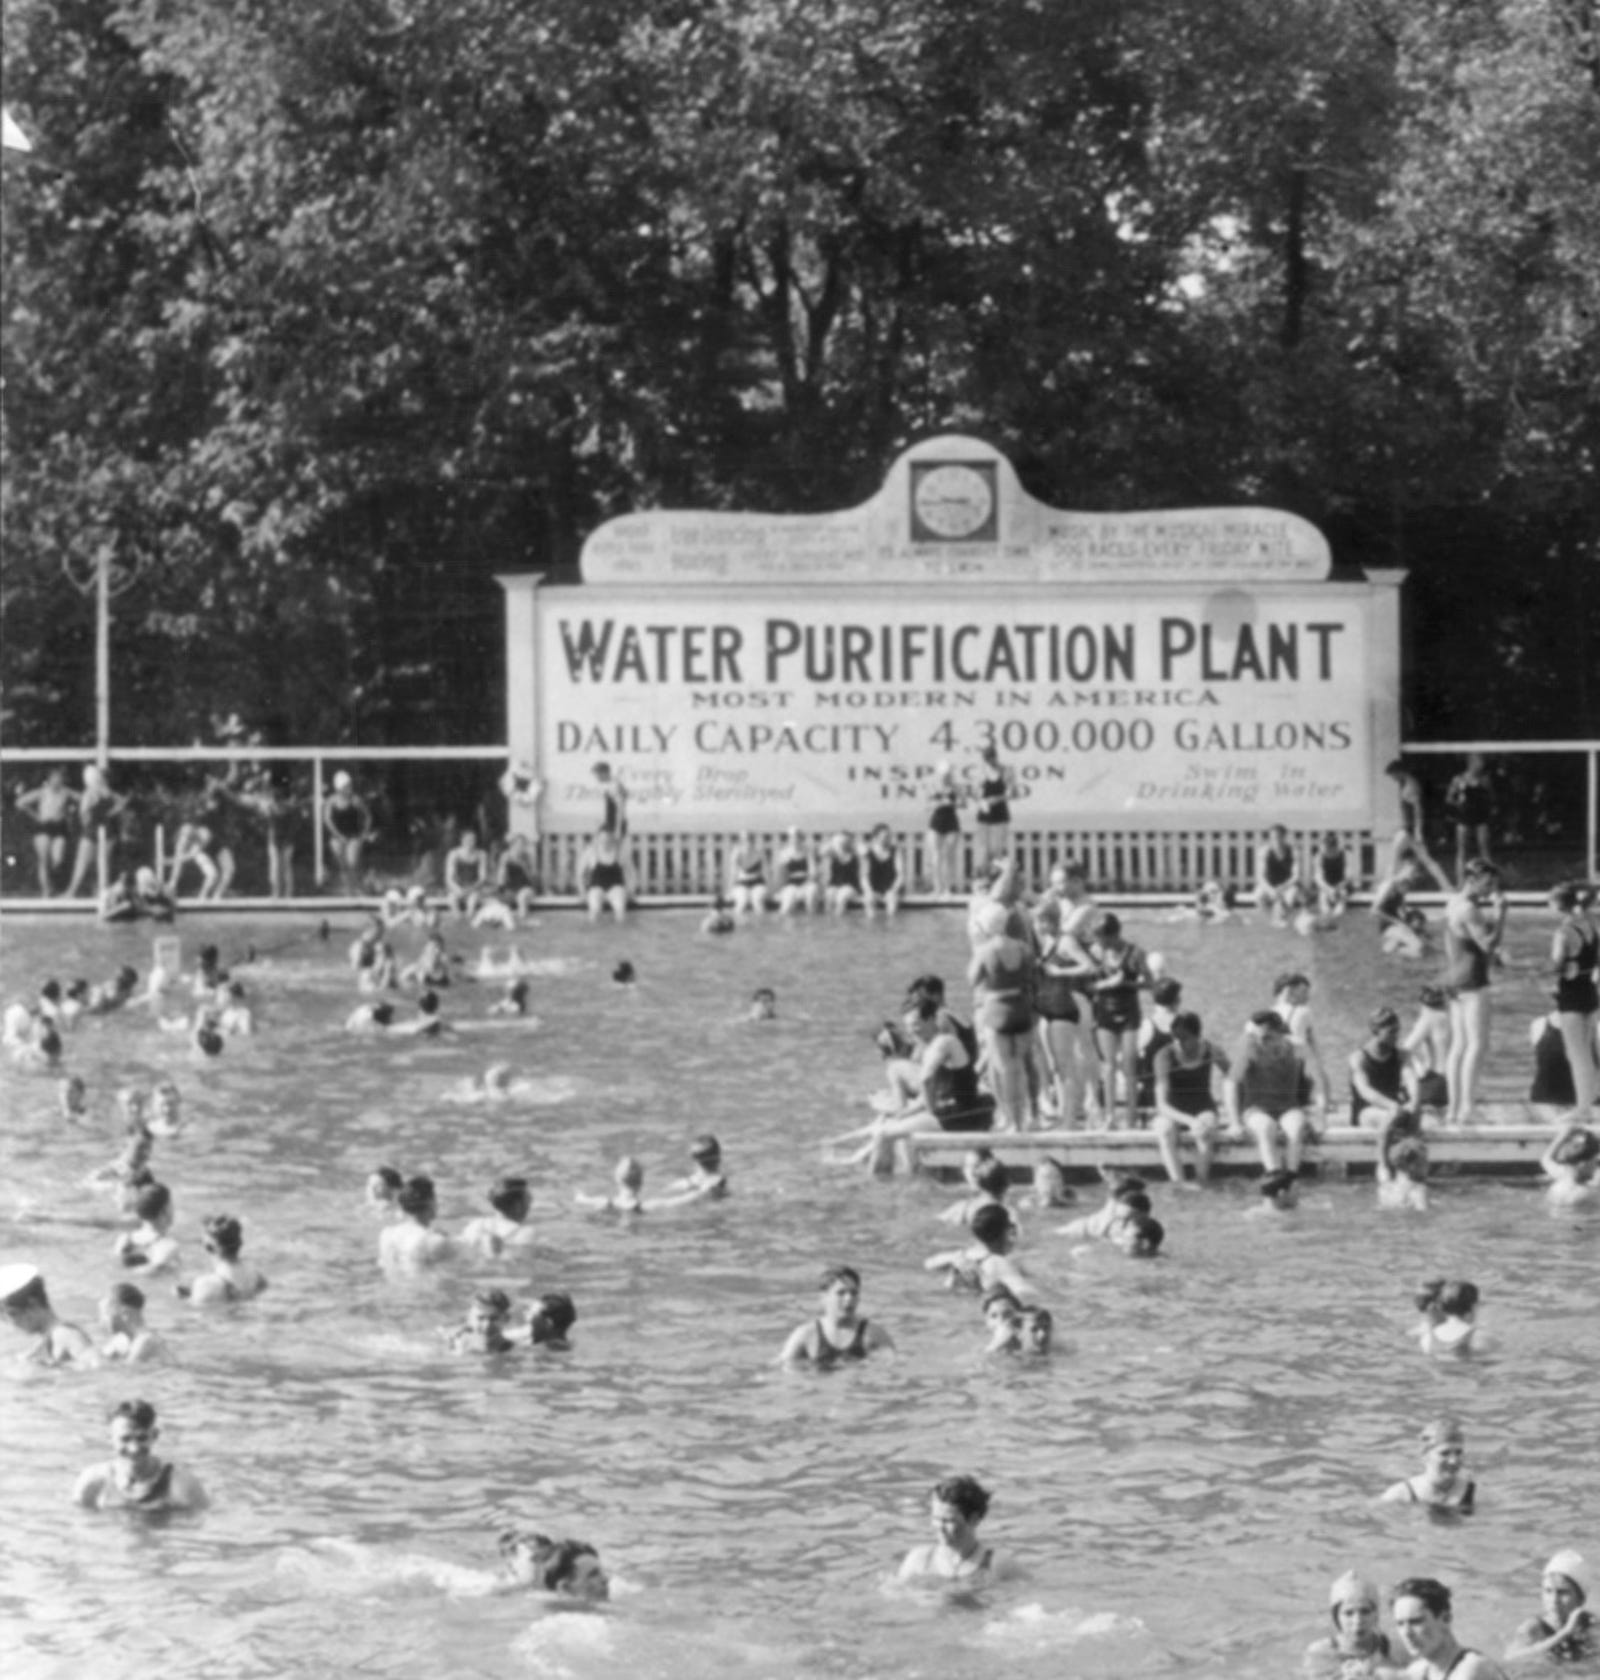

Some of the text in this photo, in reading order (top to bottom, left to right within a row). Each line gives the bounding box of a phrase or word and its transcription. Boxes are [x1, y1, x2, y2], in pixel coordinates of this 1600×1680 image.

[558, 616, 1346, 684] WATER PURIFICATION PLANT
[691, 688, 1222, 709] MOST MODERN IN AMERICA
[556, 719, 678, 754] DAILY
[693, 719, 901, 755] CAPACITY
[1174, 718, 1354, 753] GALLONS
[1136, 781, 1260, 804] Drinking
